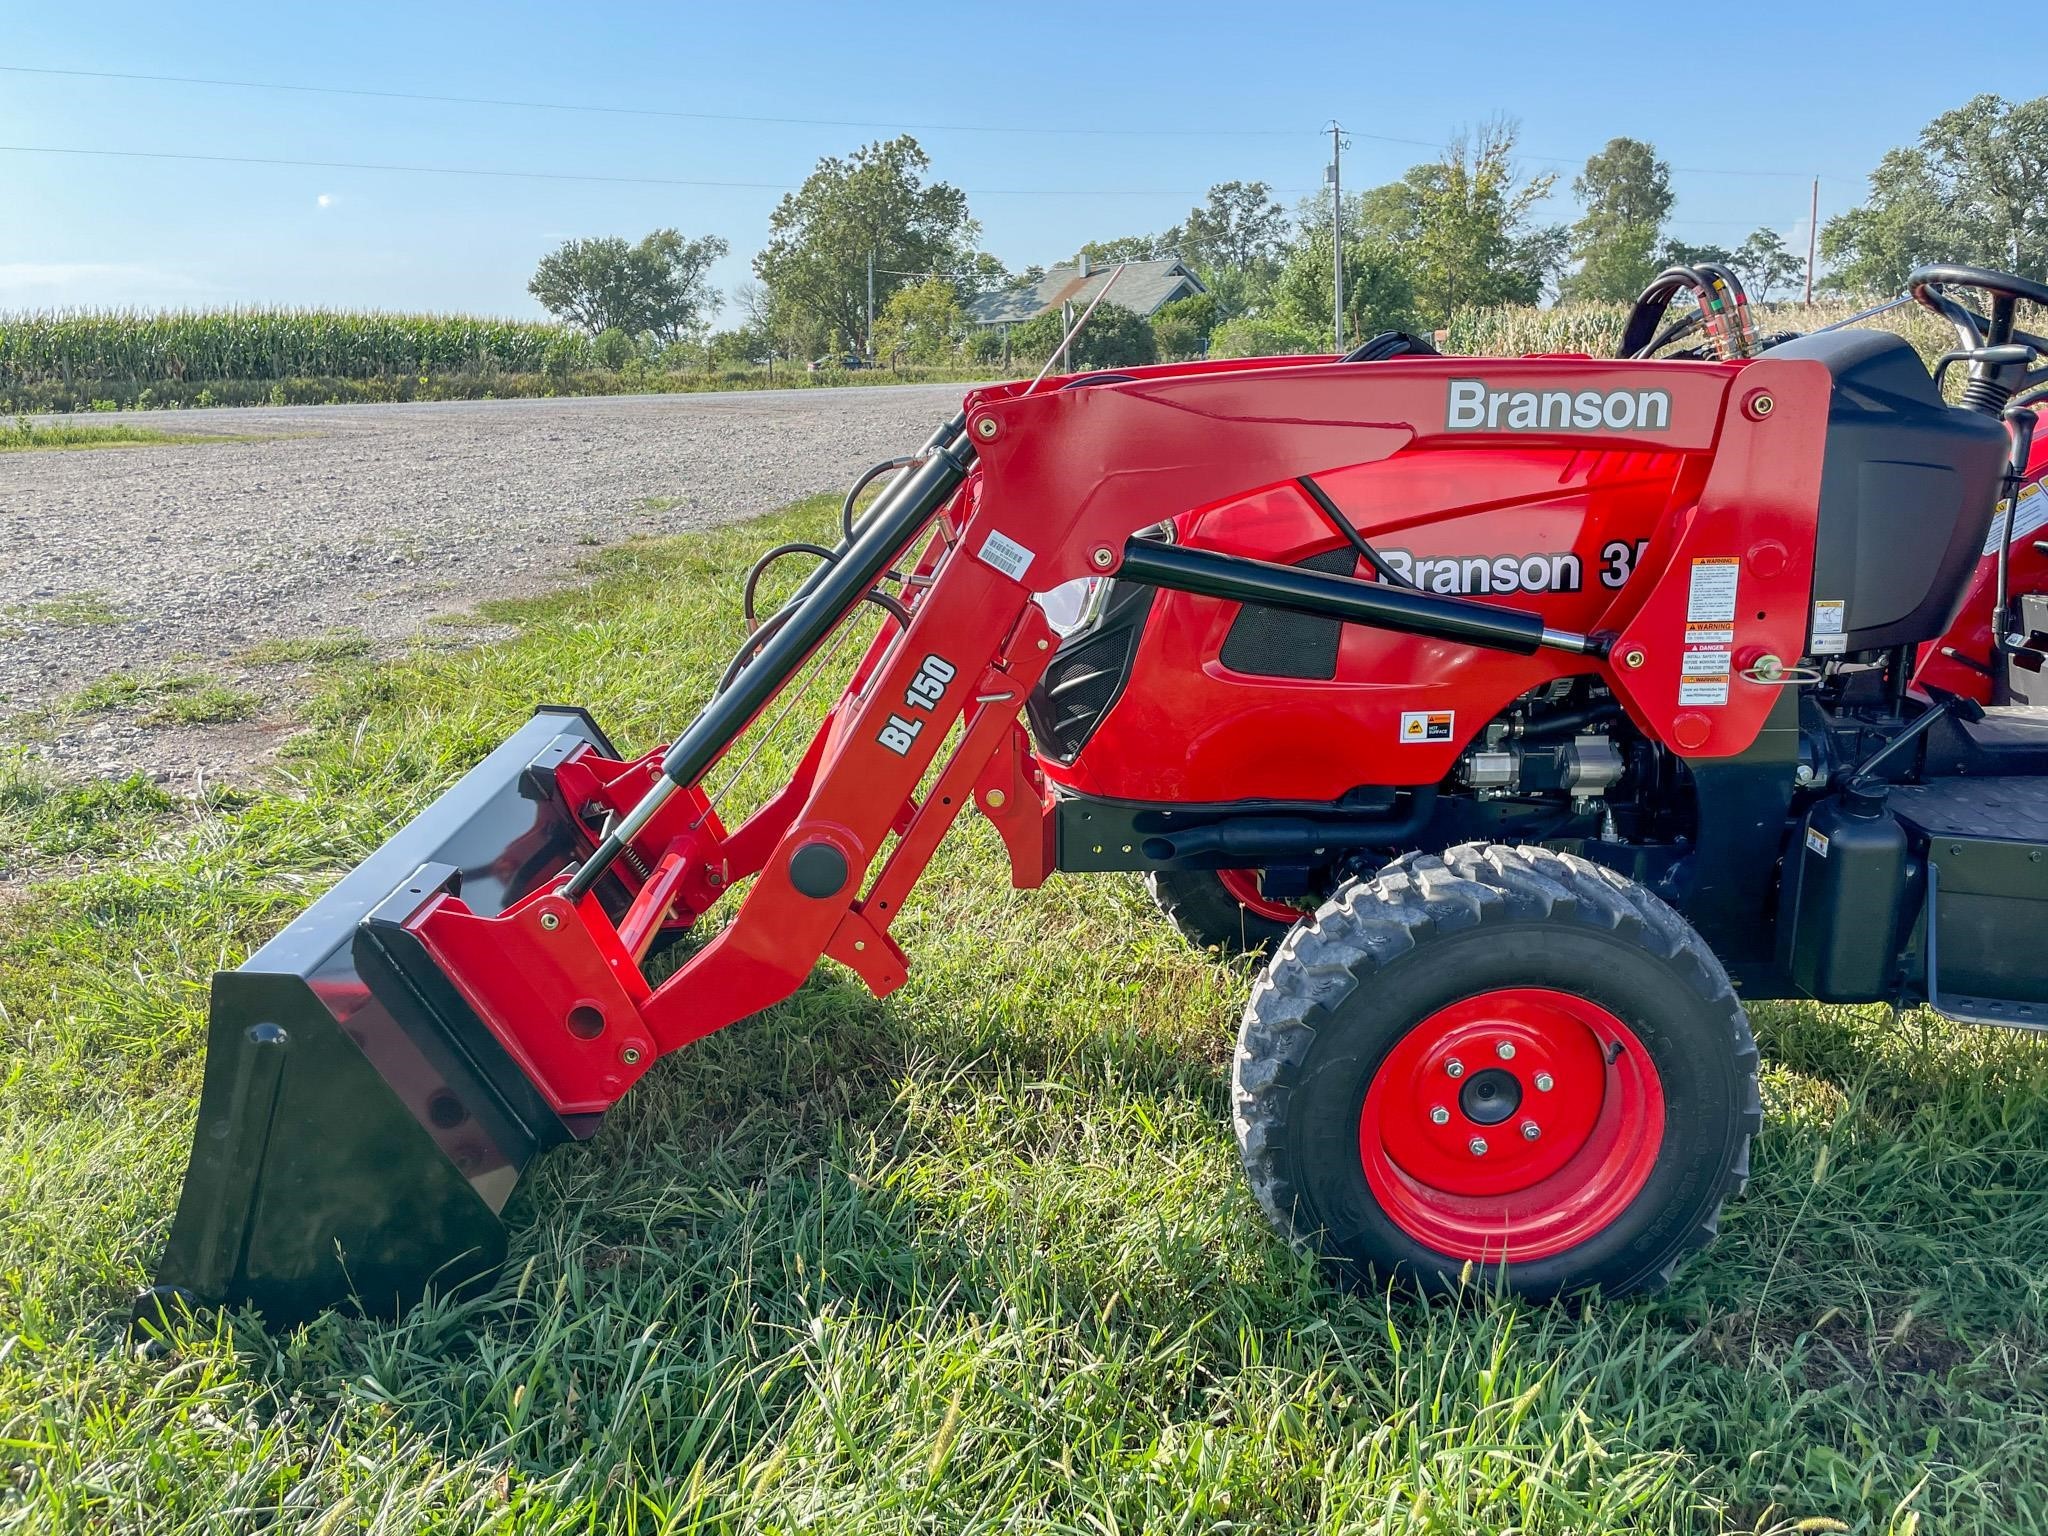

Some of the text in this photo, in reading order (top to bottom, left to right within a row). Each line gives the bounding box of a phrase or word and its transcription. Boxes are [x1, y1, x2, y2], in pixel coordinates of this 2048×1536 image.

[1448, 380, 1669, 429] Branson
[1377, 551, 1581, 594] Branson
[877, 654, 956, 756] BL 150
